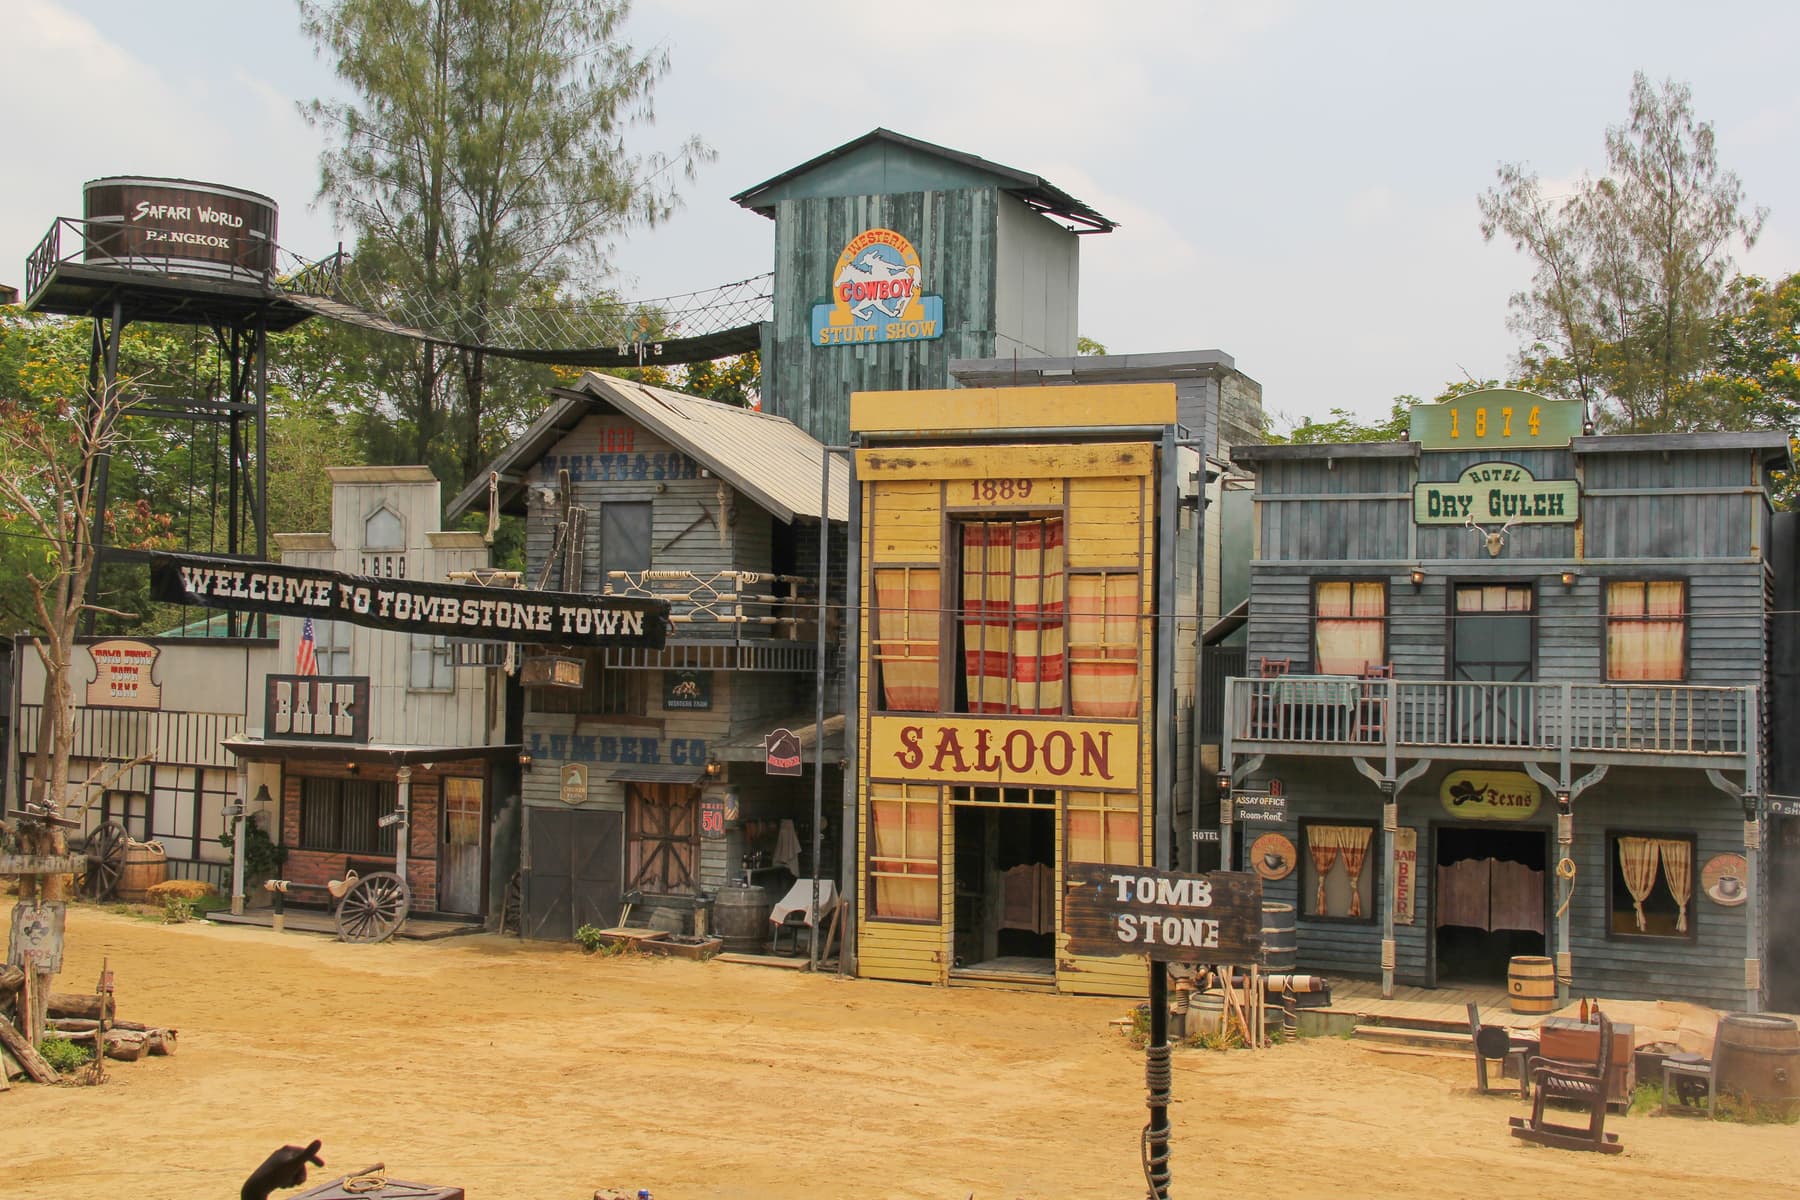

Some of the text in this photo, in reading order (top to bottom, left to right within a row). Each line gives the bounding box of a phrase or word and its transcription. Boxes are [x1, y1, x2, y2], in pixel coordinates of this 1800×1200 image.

[132, 201, 243, 228] SAFARI WORLD
[848, 231, 908, 256] WESTERN
[840, 278, 914, 302] COWBOY
[820, 319, 937, 344] STUNT SHOW
[1451, 405, 1540, 439] 1874
[1468, 469, 1521, 484] HOTEL
[971, 479, 1034, 501] 1889
[1428, 488, 1564, 517] DRY GULCH
[181, 567, 645, 636] WELCOME TO TOMBSTONE TOWN
[275, 681, 354, 737] BANK
[530, 733, 662, 764] LUMBER
[893, 726, 1115, 780] SALOON
[1236, 796, 1285, 806] ASSAY OFFICE
[1487, 789, 1532, 808] Texas
[1783, 806, 1800, 815] SH
[1192, 831, 1219, 841] HOTEL
[1393, 850, 1416, 861] BAR
[1110, 875, 1212, 907] TOMB
[1397, 862, 1409, 914] BEER
[1117, 914, 1219, 948] STONE
